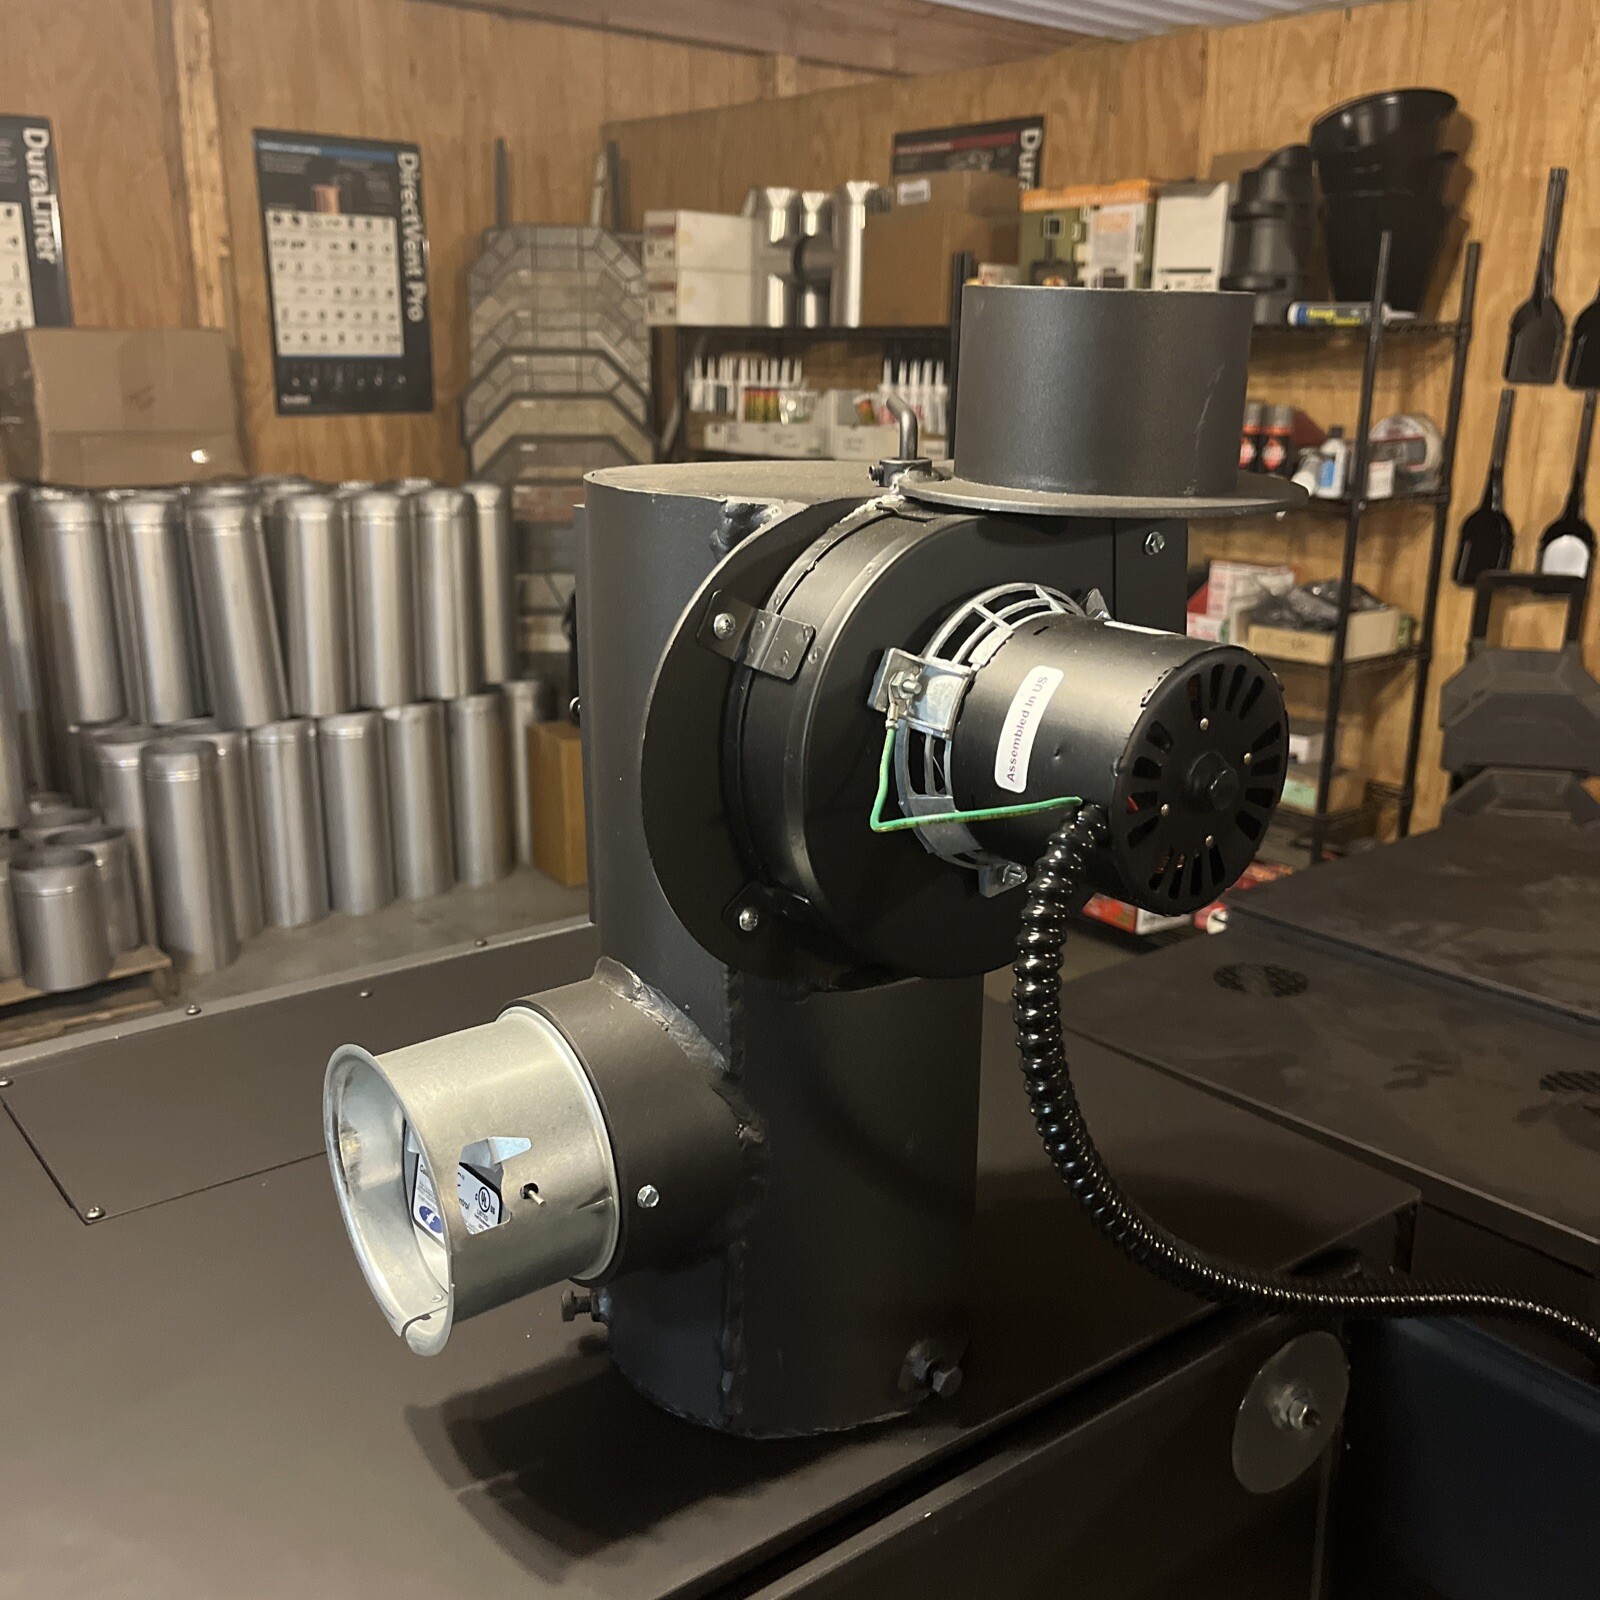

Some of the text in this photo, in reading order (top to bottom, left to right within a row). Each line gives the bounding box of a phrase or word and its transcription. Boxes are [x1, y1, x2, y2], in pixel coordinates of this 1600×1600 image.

[22, 127, 57, 264] DuraLiner
[397, 152, 428, 323] DirectVent Pro
[1006, 676, 1048, 783] Assembled In US
